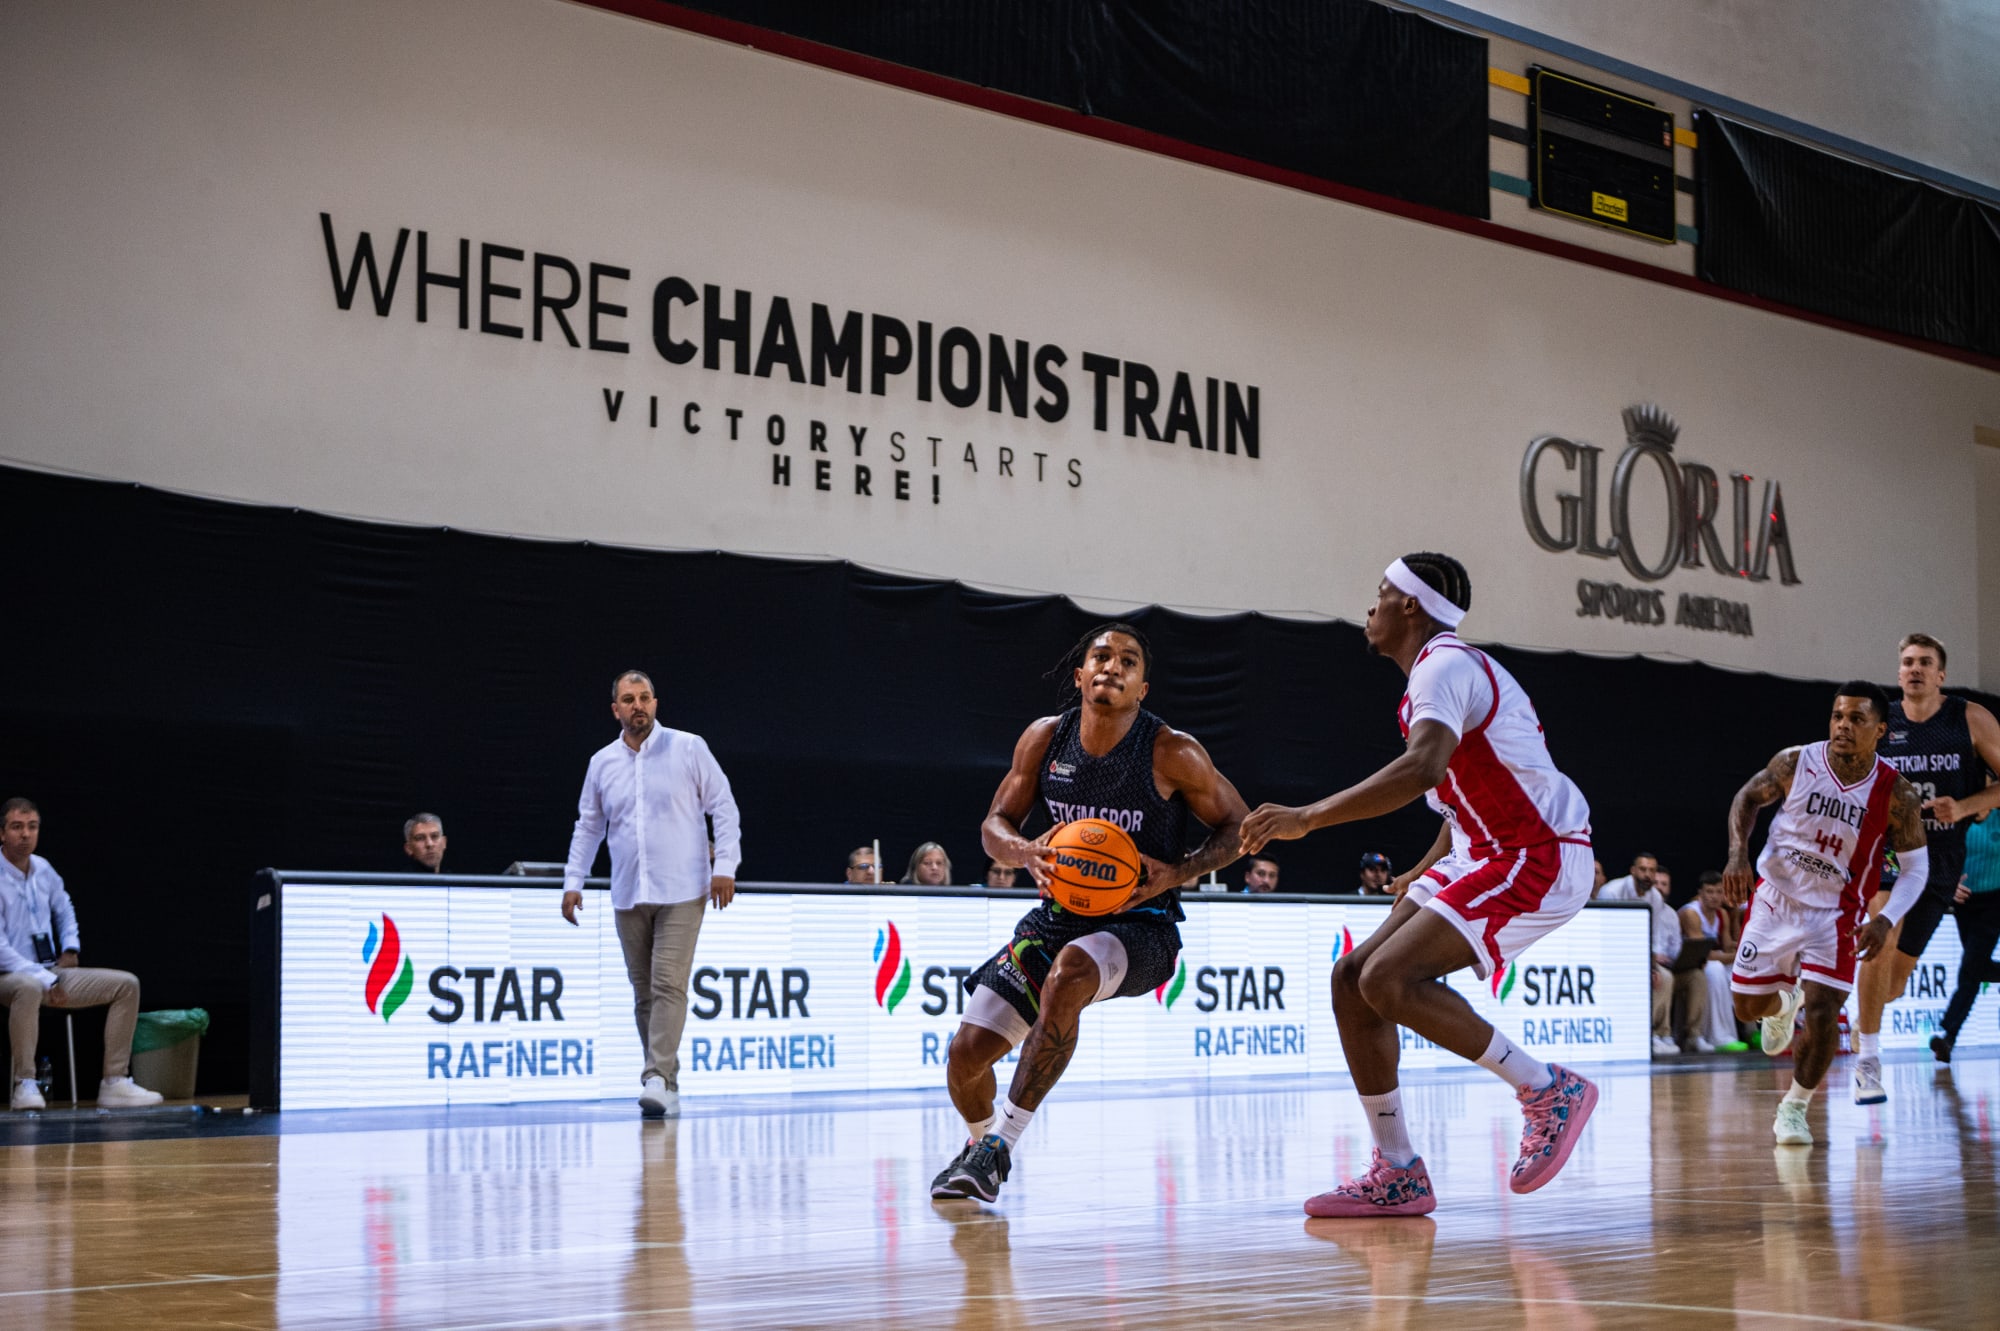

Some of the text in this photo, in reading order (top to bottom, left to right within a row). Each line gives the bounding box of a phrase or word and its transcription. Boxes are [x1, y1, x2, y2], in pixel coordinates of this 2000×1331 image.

[319, 212, 1260, 459] WHERE CHAMPIONS TRAIN
[602, 388, 1083, 488] VICTORY STARTS
[772, 454, 942, 504] HERE!
[1519, 436, 1802, 586] GLORIA
[1576, 578, 1666, 627] SPORTS
[1930, 753, 1961, 771] SPOR
[1100, 807, 1144, 832] SPOR
[1806, 792, 1869, 830] CHOLET
[1815, 829, 1844, 857] 44
[1056, 854, 1117, 882] Wilson
[427, 965, 565, 1024] STAR
[691, 966, 811, 1021] STAR
[921, 966, 972, 1016] ST
[1003, 961, 1028, 984] STAR
[1195, 966, 1285, 1012] STAR
[1523, 964, 1596, 1006] STAR
[1908, 963, 1947, 998] TAR
